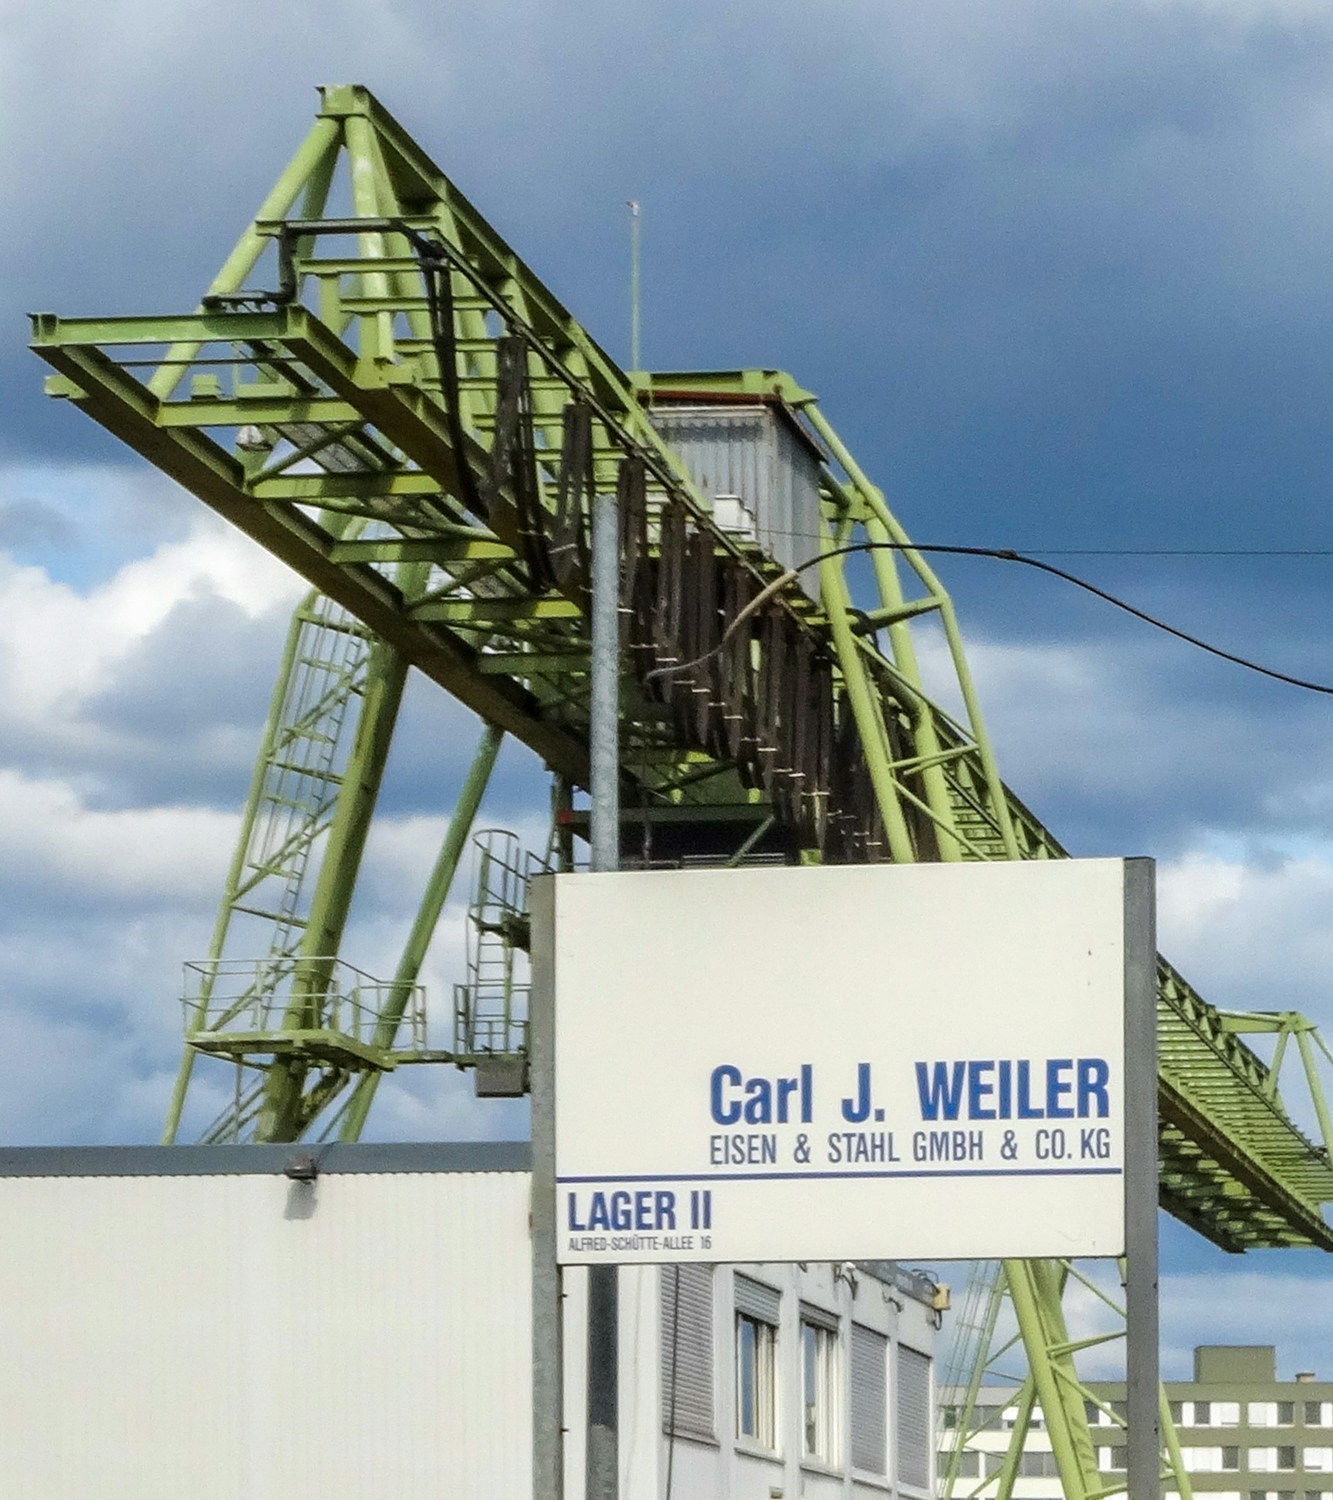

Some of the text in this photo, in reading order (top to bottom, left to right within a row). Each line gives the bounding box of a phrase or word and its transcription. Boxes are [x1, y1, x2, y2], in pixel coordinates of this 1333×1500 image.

[710, 1058, 1110, 1126] Carl J. WEILER
[710, 1128, 1110, 1165] EISEN & STAHL GMBH & CO. KG
[568, 1190, 711, 1231] LAGER II
[568, 1234, 712, 1251] ALFRED-SCHÜTTE-ALLEE 16
